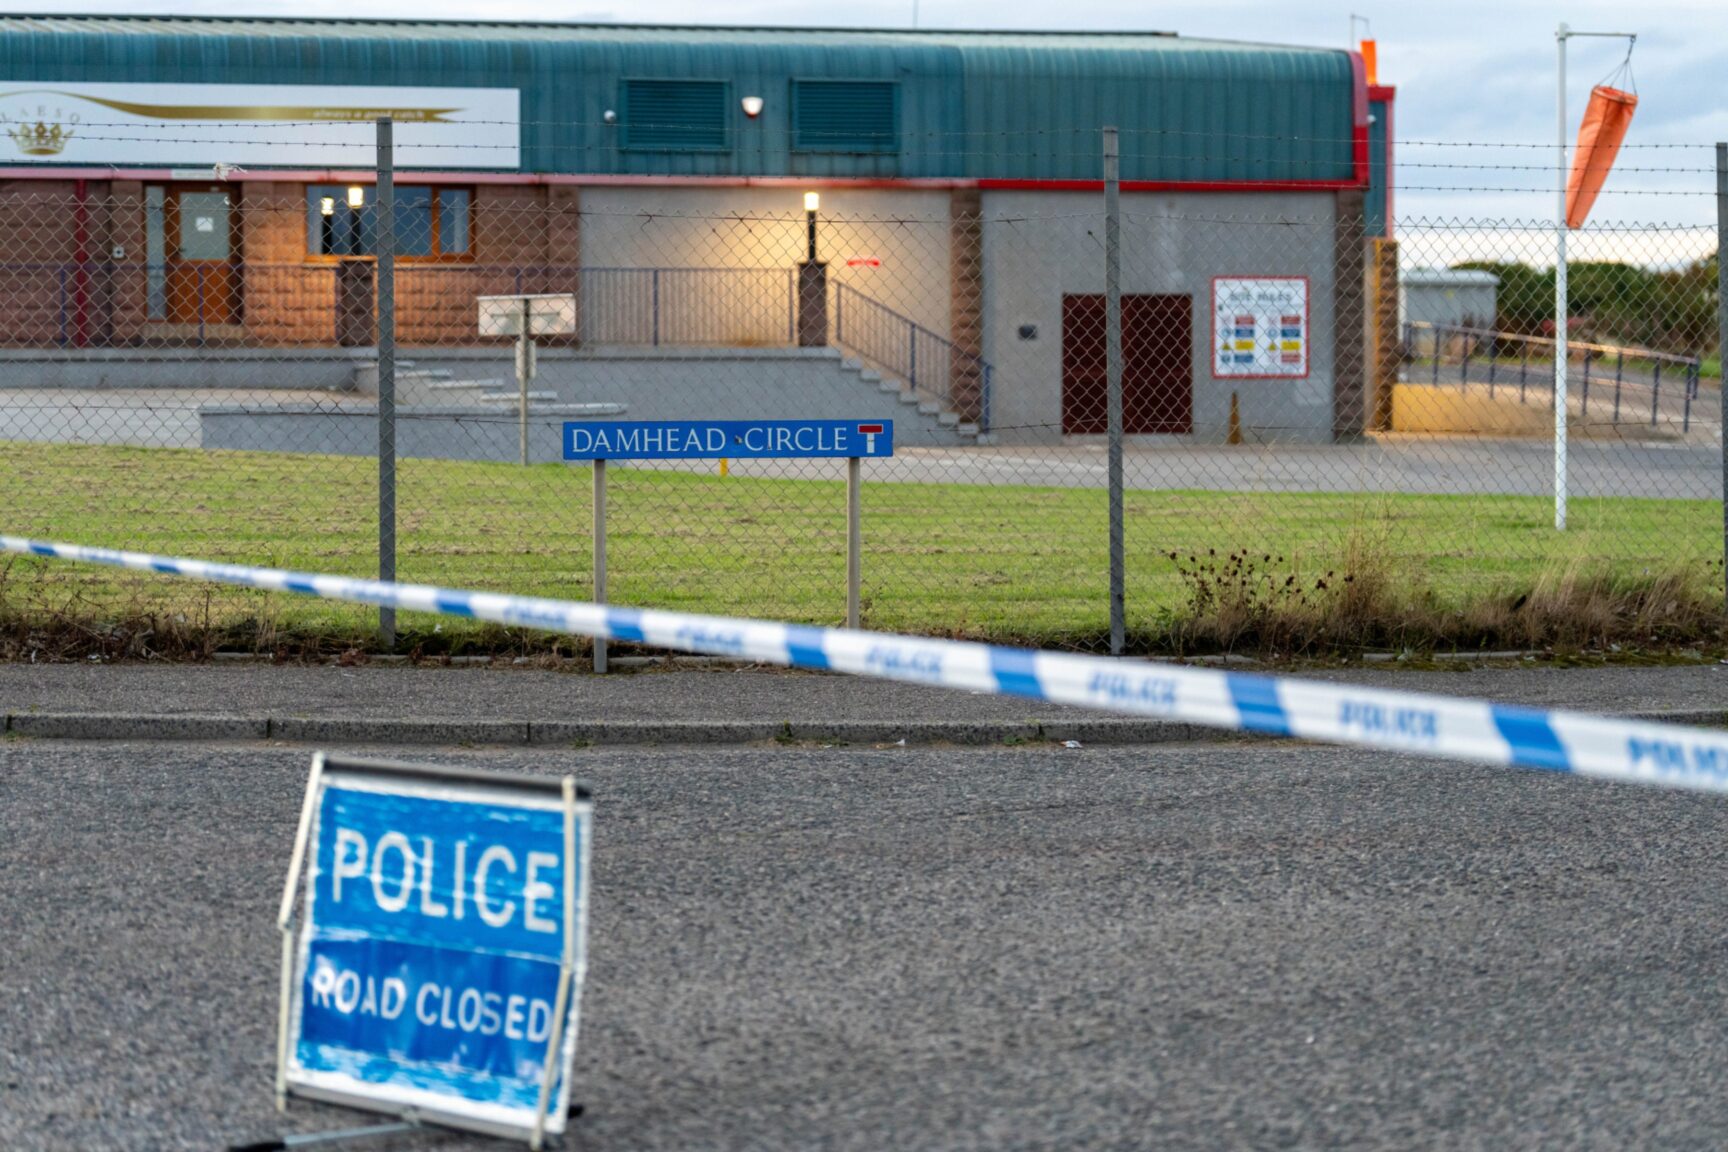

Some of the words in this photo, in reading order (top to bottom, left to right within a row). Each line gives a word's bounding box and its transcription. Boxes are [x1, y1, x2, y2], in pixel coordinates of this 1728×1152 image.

[572, 427, 726, 453] DAMHEAD
[744, 427, 848, 451] CIRCLE
[333, 826, 558, 934] POLICE
[311, 955, 406, 1020] ROAD
[415, 983, 551, 1043] CLOSED
